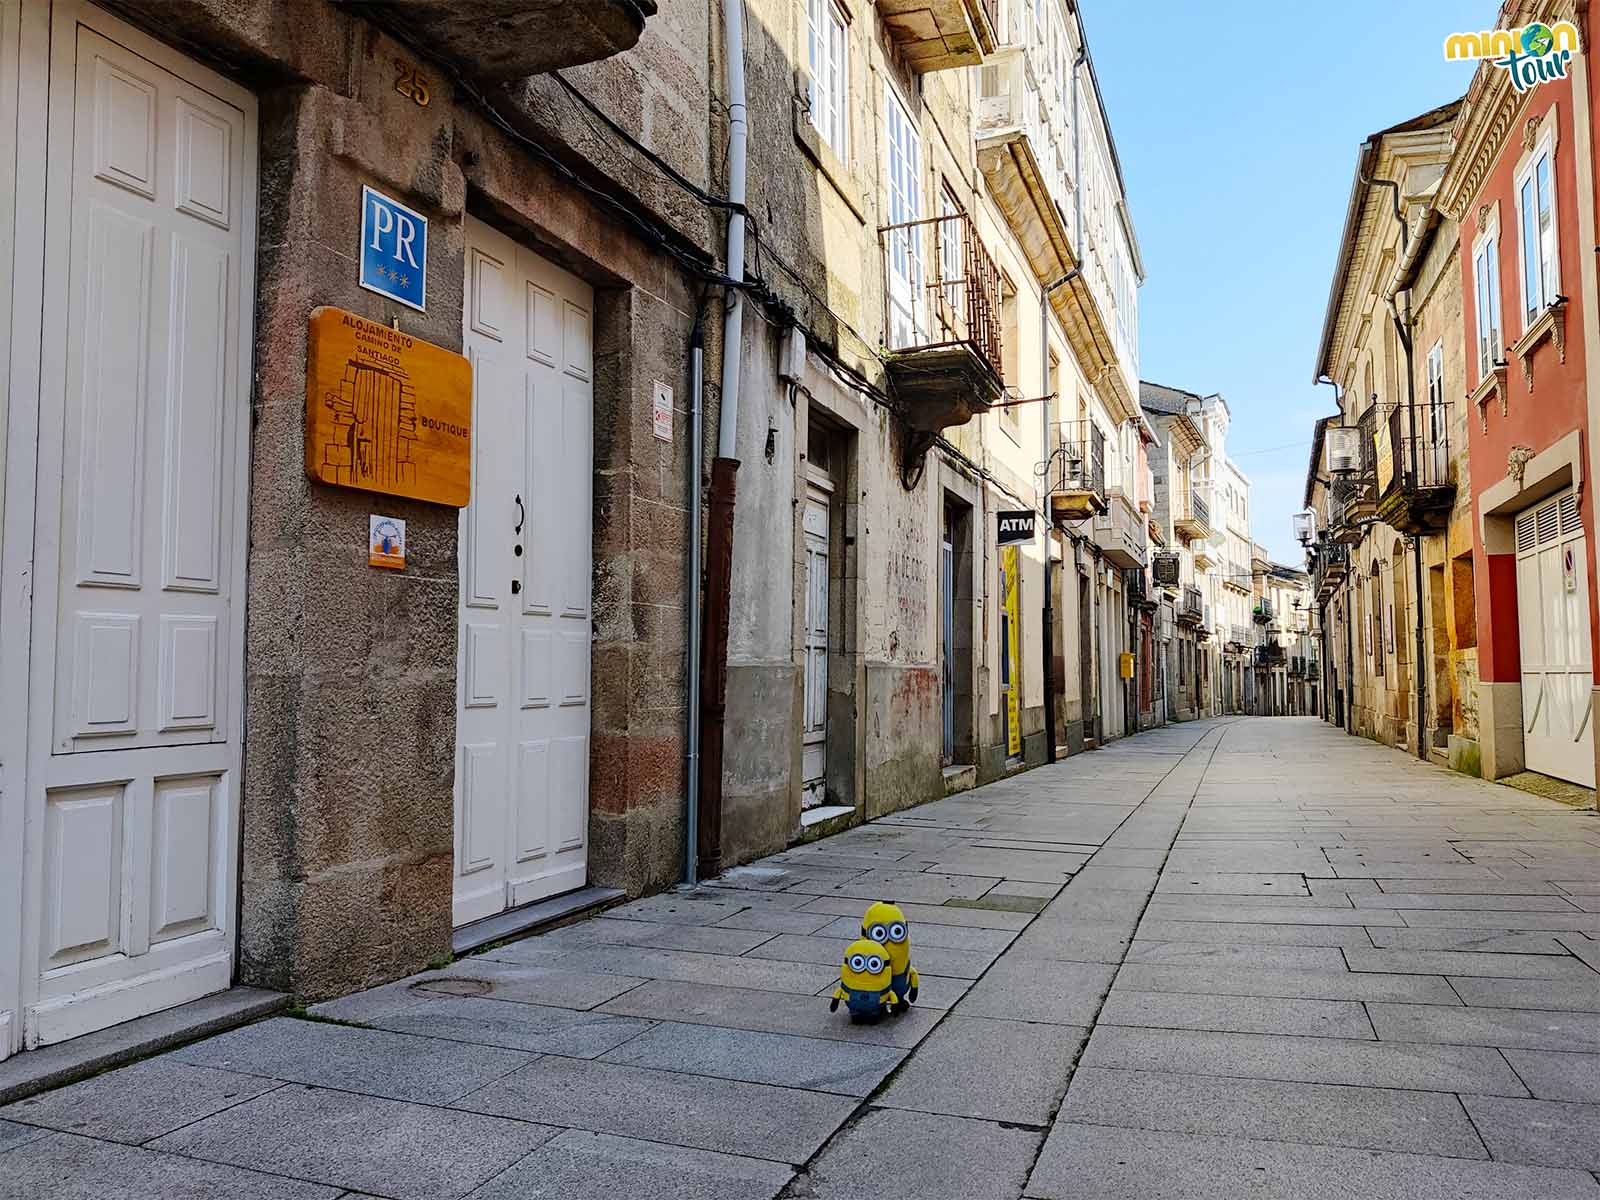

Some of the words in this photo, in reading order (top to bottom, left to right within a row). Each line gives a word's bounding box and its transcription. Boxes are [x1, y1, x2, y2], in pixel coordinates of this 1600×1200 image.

[394, 59, 430, 107] 25
[369, 199, 420, 269] PR
[342, 315, 413, 349] ALOJAMIENTO
[355, 332, 389, 349] CAMINO
[390, 343, 402, 353] DE
[356, 345, 400, 365] SANTIAGO
[421, 416, 468, 438] BOUTIQUE
[999, 518, 1034, 532] ATM
